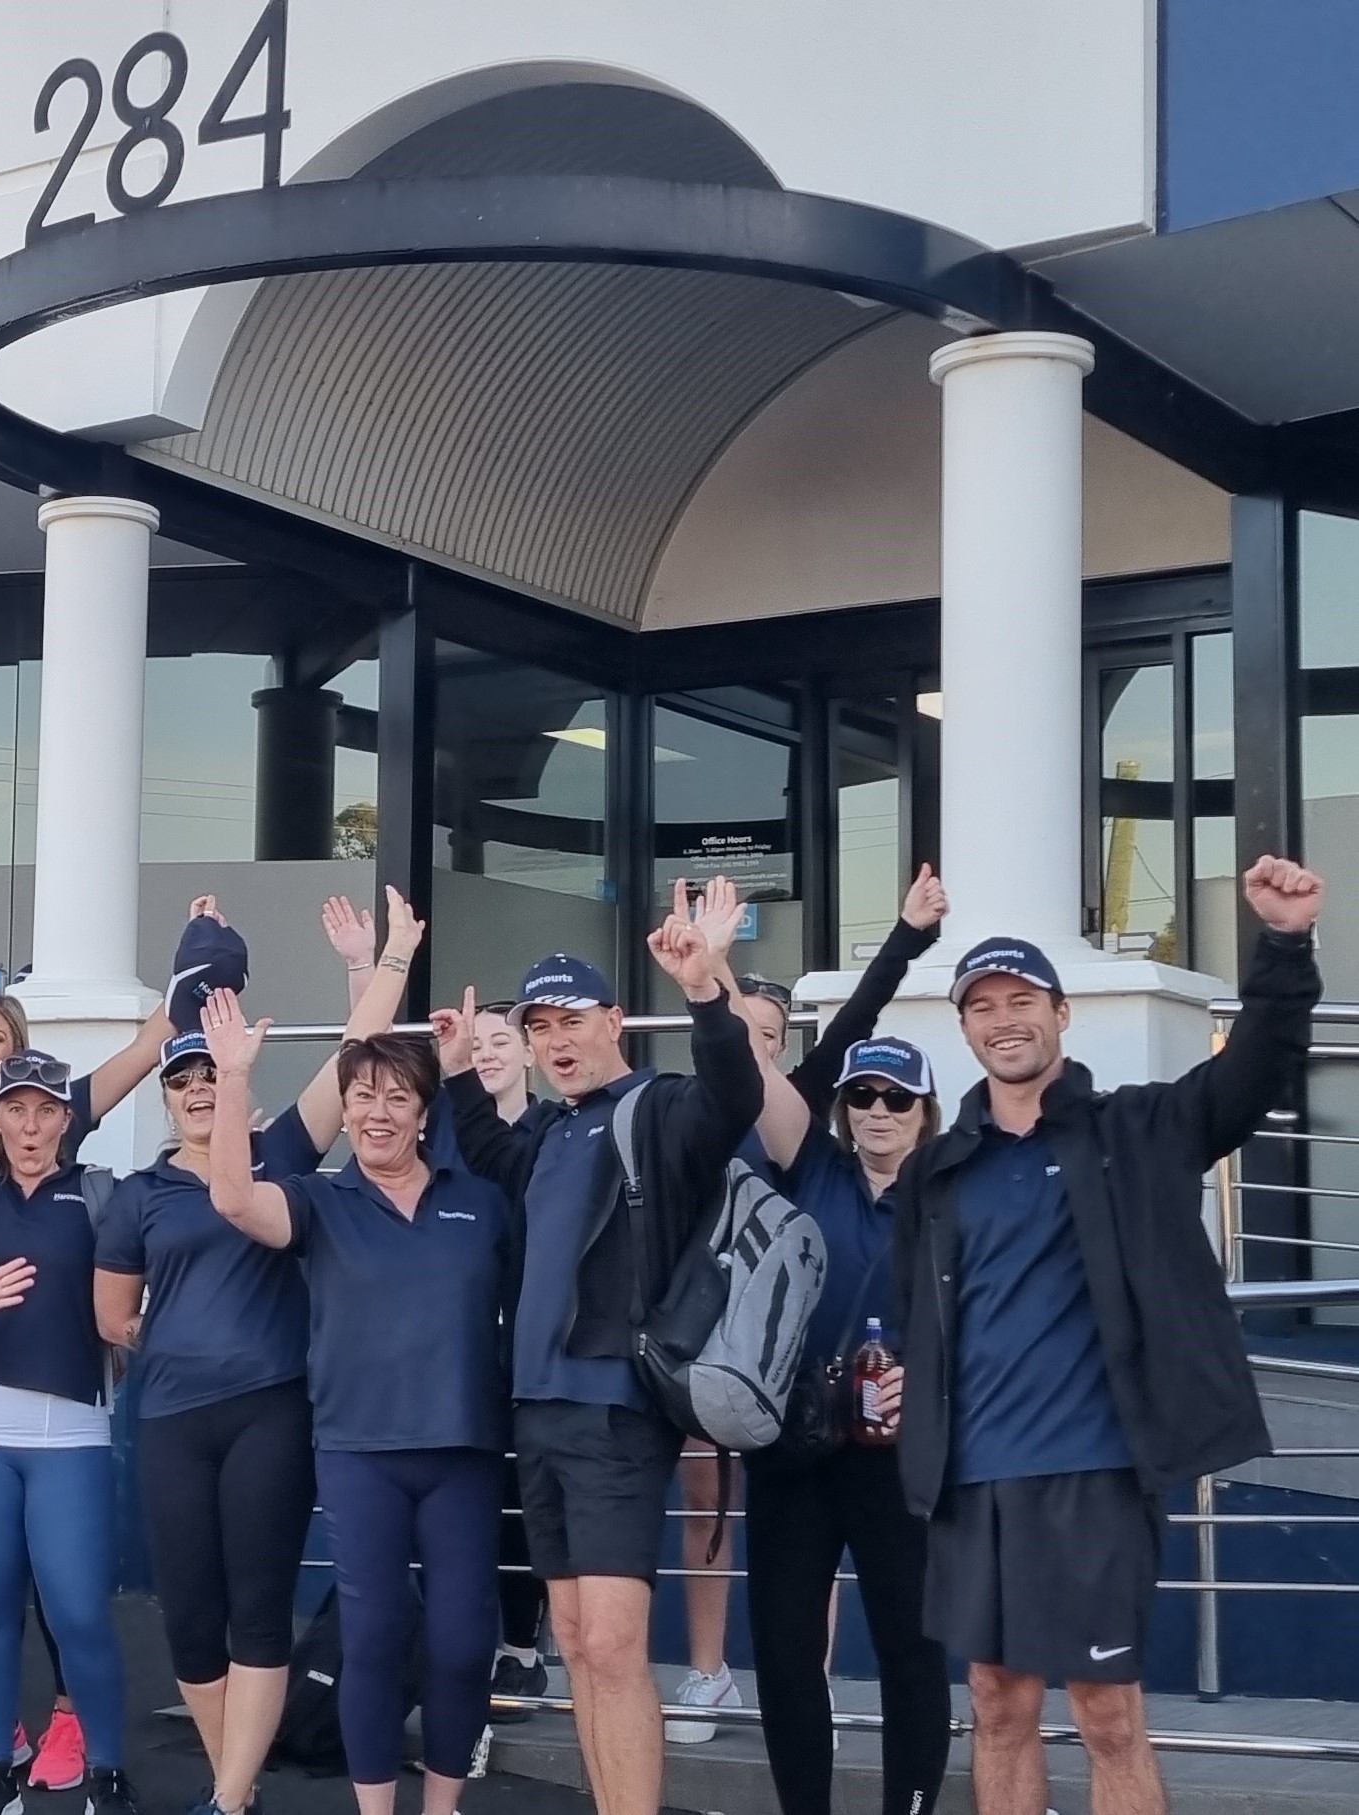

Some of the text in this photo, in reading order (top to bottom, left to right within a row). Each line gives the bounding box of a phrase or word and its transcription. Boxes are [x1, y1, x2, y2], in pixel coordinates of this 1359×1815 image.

[25, 0, 291, 250] 284
[702, 835, 752, 846] Office Hours
[966, 949, 1025, 970] Harcourts
[525, 973, 574, 995] Harcourts
[171, 1032, 205, 1047] Harcou
[171, 1039, 205, 1055] Mandur
[856, 1045, 912, 1061] Harcourts
